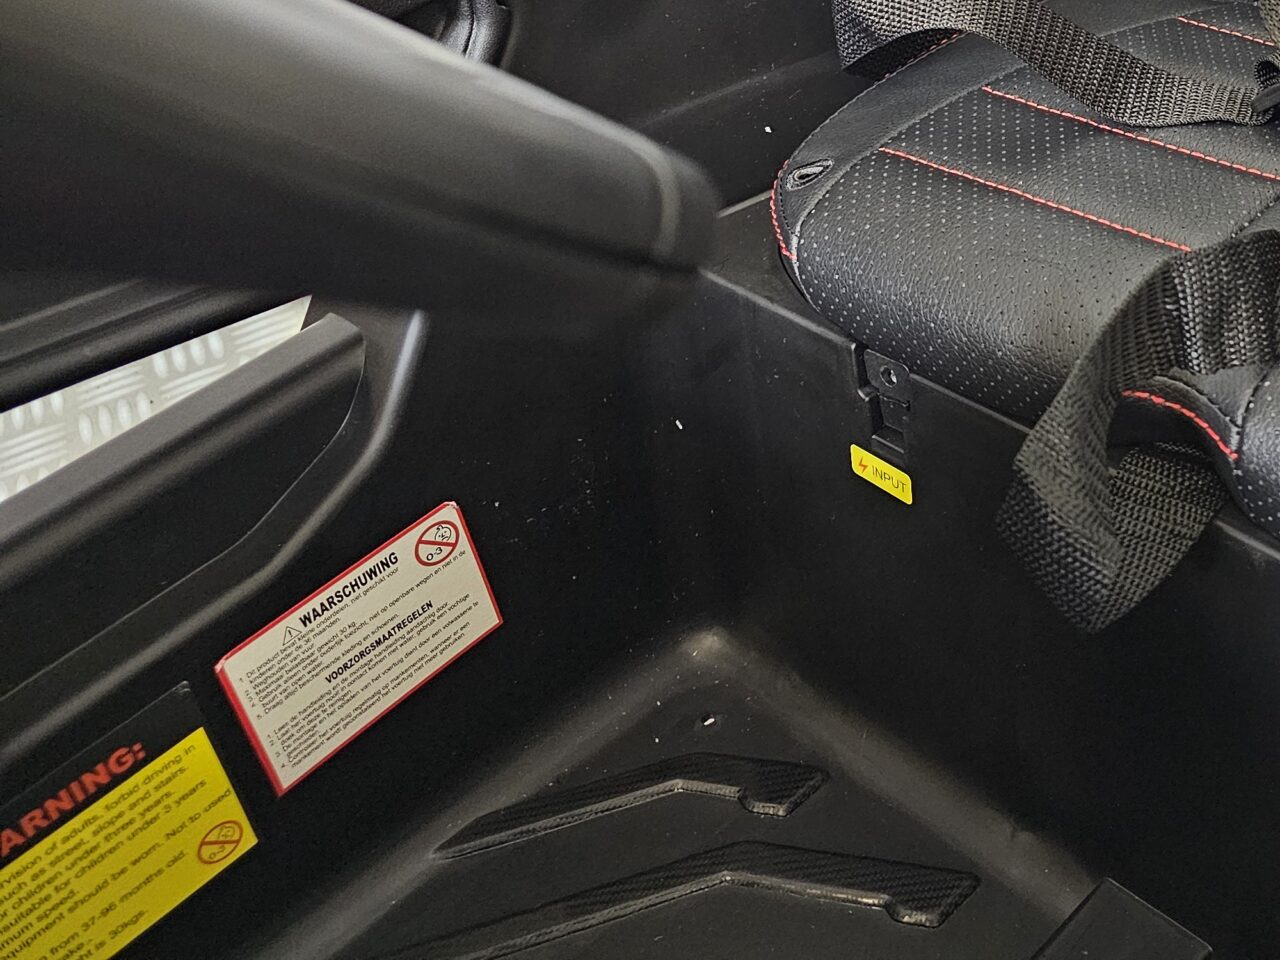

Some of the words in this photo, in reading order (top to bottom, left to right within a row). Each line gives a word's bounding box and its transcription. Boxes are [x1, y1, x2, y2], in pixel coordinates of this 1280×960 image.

[872, 465, 906, 493] INPUT
[298, 551, 399, 628] WAARSCHUWING
[425, 545, 443, 562] 0-3
[248, 662, 276, 684] kinderen
[276, 649, 294, 664] onder
[294, 642, 302, 651] de
[302, 636, 311, 645] 36
[255, 651, 280, 672] product
[279, 639, 297, 654] bevat
[297, 626, 315, 642] kleine
[315, 601, 350, 629] onderdelen,
[350, 593, 361, 604] niet
[362, 575, 386, 596] geschikt
[385, 567, 399, 578] voor
[255, 672, 284, 696] Maximaal
[284, 649, 316, 675] belastbaar
[316, 632, 339, 652] gewicht
[338, 626, 347, 635] 30
[258, 682, 282, 702] Gebruik
[282, 668, 301, 684] alleen
[301, 655, 319, 671] onder
[319, 637, 344, 658] ouderlijk
[368, 610, 380, 621] niet
[380, 606, 388, 614] op
[388, 585, 415, 608] openbare
[415, 573, 433, 589] wegen
[441, 559, 452, 569] niet
[458, 549, 465, 557] de
[264, 697, 284, 715] Draag
[283, 686, 298, 701] altijd
[298, 654, 341, 689] beschermende
[341, 639, 362, 657] kleding
[362, 633, 370, 641] en
[370, 612, 399, 635] schoenen.
[276, 727, 290, 740] Laat
[290, 718, 301, 729] het
[301, 701, 325, 722] voertuig
[325, 689, 340, 703] nooit
[346, 669, 367, 687] contact
[367, 654, 387, 671] komen
[387, 645, 398, 656] met
[416, 617, 436, 635] gebruik
[436, 609, 447, 620] een
[447, 592, 470, 612] vochtige
[324, 600, 433, 684] VOORZORGSMAATREGELEN
[252, 661, 289, 691] Weghouden
[289, 654, 300, 664] van
[261, 693, 278, 707] buurt
[278, 685, 290, 695] van
[290, 673, 306, 687] open
[273, 720, 289, 734] Lees
[289, 713, 298, 723] de
[297, 688, 331, 717] handleiding
[332, 682, 340, 691] en
[340, 675, 348, 684] de
[348, 657, 374, 679] montage
[373, 632, 405, 660] handleiding
[405, 610, 435, 636] aandachtig
[282, 741, 292, 752] De
[292, 722, 318, 745] montage
[318, 715, 326, 724] en
[326, 707, 336, 717] het
[336, 689, 360, 711] opladen
[360, 681, 371, 692] van
[371, 673, 381, 683] het
[381, 656, 404, 676] voertuig
[403, 645, 418, 659] dient
[417, 635, 430, 648] door
[431, 628, 441, 638] een
[441, 604, 472, 630] volwassene
[472, 599, 478, 607] te
[290, 739, 325, 768] mankement
[325, 726, 341, 742] wordt
[341, 695, 381, 729] geconstateerd
[381, 688, 391, 698] het
[391, 671, 413, 691] voertuig
[413, 662, 424, 673] niet
[424, 652, 438, 665] meer
[318, 728, 328, 739] het
[328, 711, 352, 732] voertuig
[352, 688, 381, 714] regelmatig
[381, 682, 389, 691] op
[429, 633, 452, 654] wanneer
[452, 628, 459, 636] er
[459, 620, 469, 631] een
[280, 731, 294, 745] doek
[295, 724, 305, 734] om
[305, 712, 321, 726] deze
[321, 706, 328, 714] te
[29, 865, 47, 882] as
[90, 807, 126, 839] slope
[126, 788, 151, 811] and
[42, 841, 57, 857] of
[103, 781, 140, 812] forbid
[140, 752, 182, 787] driving
[182, 742, 196, 756] in
[53, 876, 71, 894] for
[73, 837, 124, 880] children
[125, 810, 161, 841] under
[162, 802, 172, 814] 3
[172, 777, 207, 808] years
[10, 867, 62, 911] children
[63, 839, 101, 872] under
[102, 813, 136, 843] three
[65, 877, 109, 915] should
[110, 863, 128, 881] be
[165, 819, 187, 840] Not
[187, 810, 201, 824] to
[202, 787, 231, 813] used
[48, 928, 79, 957] from
[117, 864, 164, 905] months
